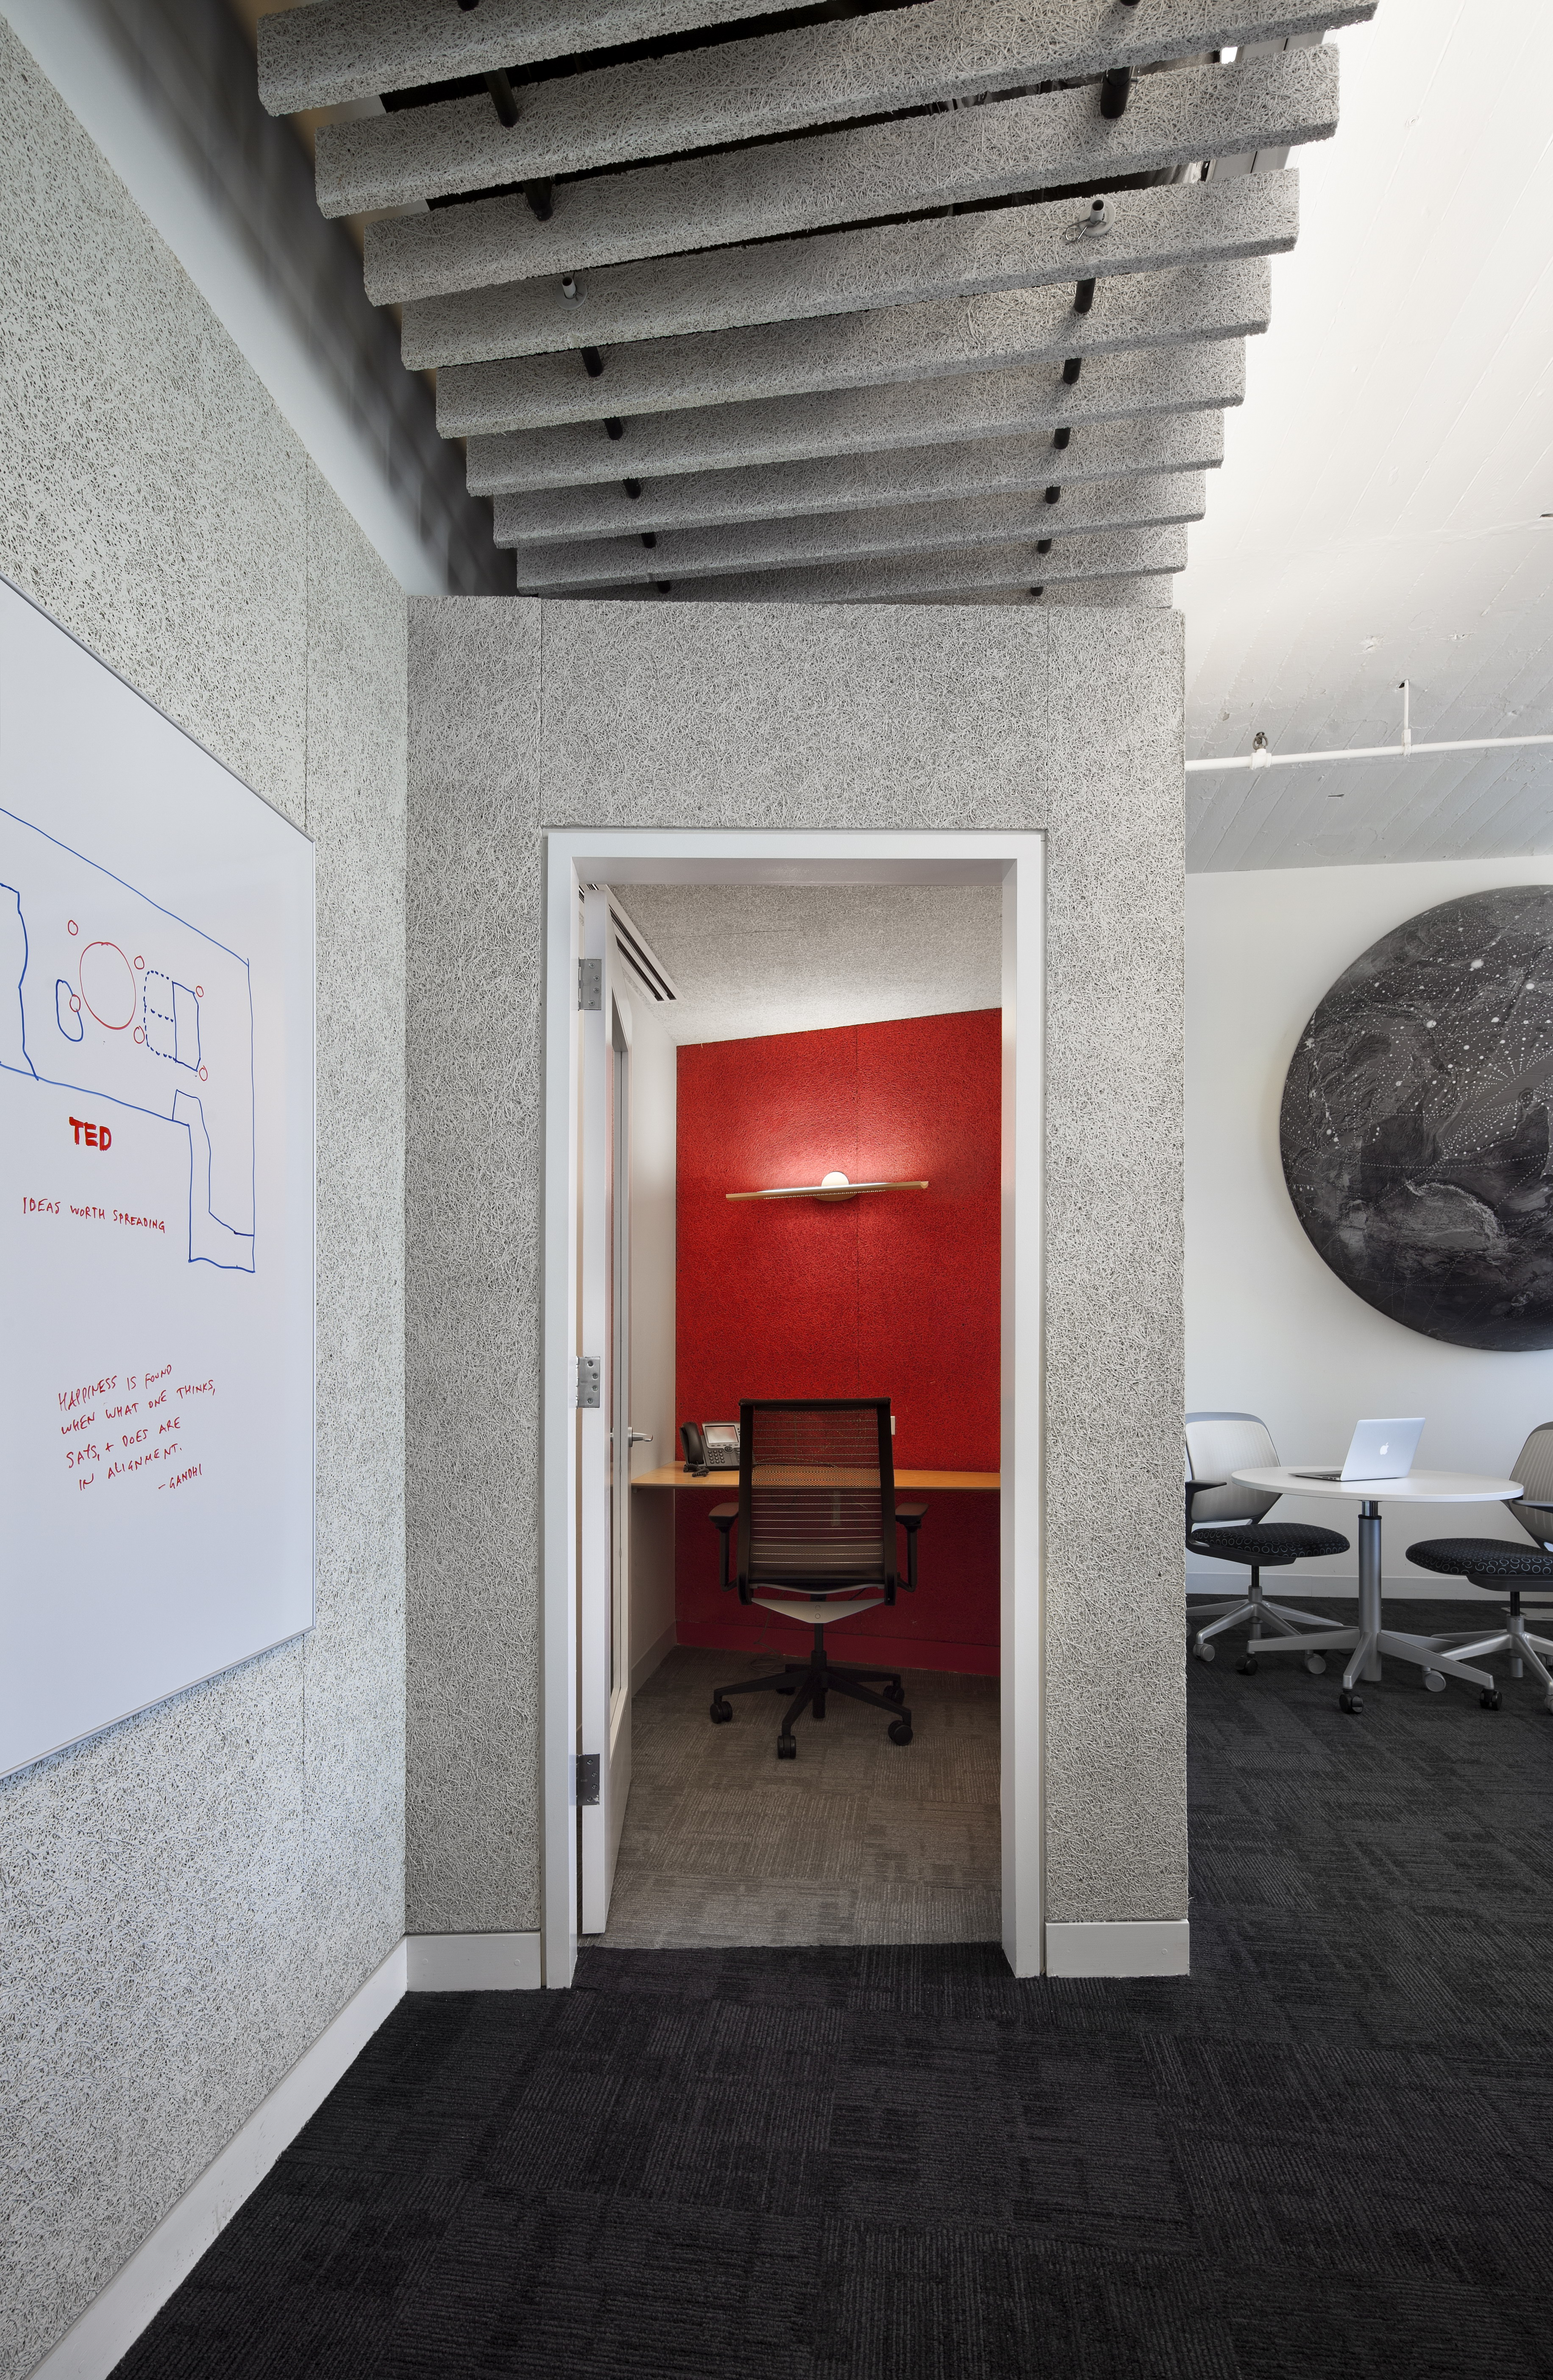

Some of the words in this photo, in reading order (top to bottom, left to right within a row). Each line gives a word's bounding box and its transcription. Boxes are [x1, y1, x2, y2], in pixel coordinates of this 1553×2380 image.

[69, 1116, 112, 1151] TED
[23, 1197, 61, 1215] IDEAS
[70, 1205, 106, 1220] WORTH
[113, 1209, 166, 1234] SPREADING
[58, 1375, 117, 1411] HAPPINESS
[127, 1376, 136, 1390] IS
[145, 1364, 172, 1389] FOUND
[61, 1412, 95, 1435] WHEN
[105, 1403, 139, 1419] WHAT
[148, 1389, 167, 1409] ONE
[176, 1379, 216, 1399] THINKS,
[122, 1429, 148, 1447] DOES
[159, 1416, 181, 1435] ARE
[79, 1473, 95, 1491] IN
[107, 1443, 182, 1479] ALIGNMENT.
